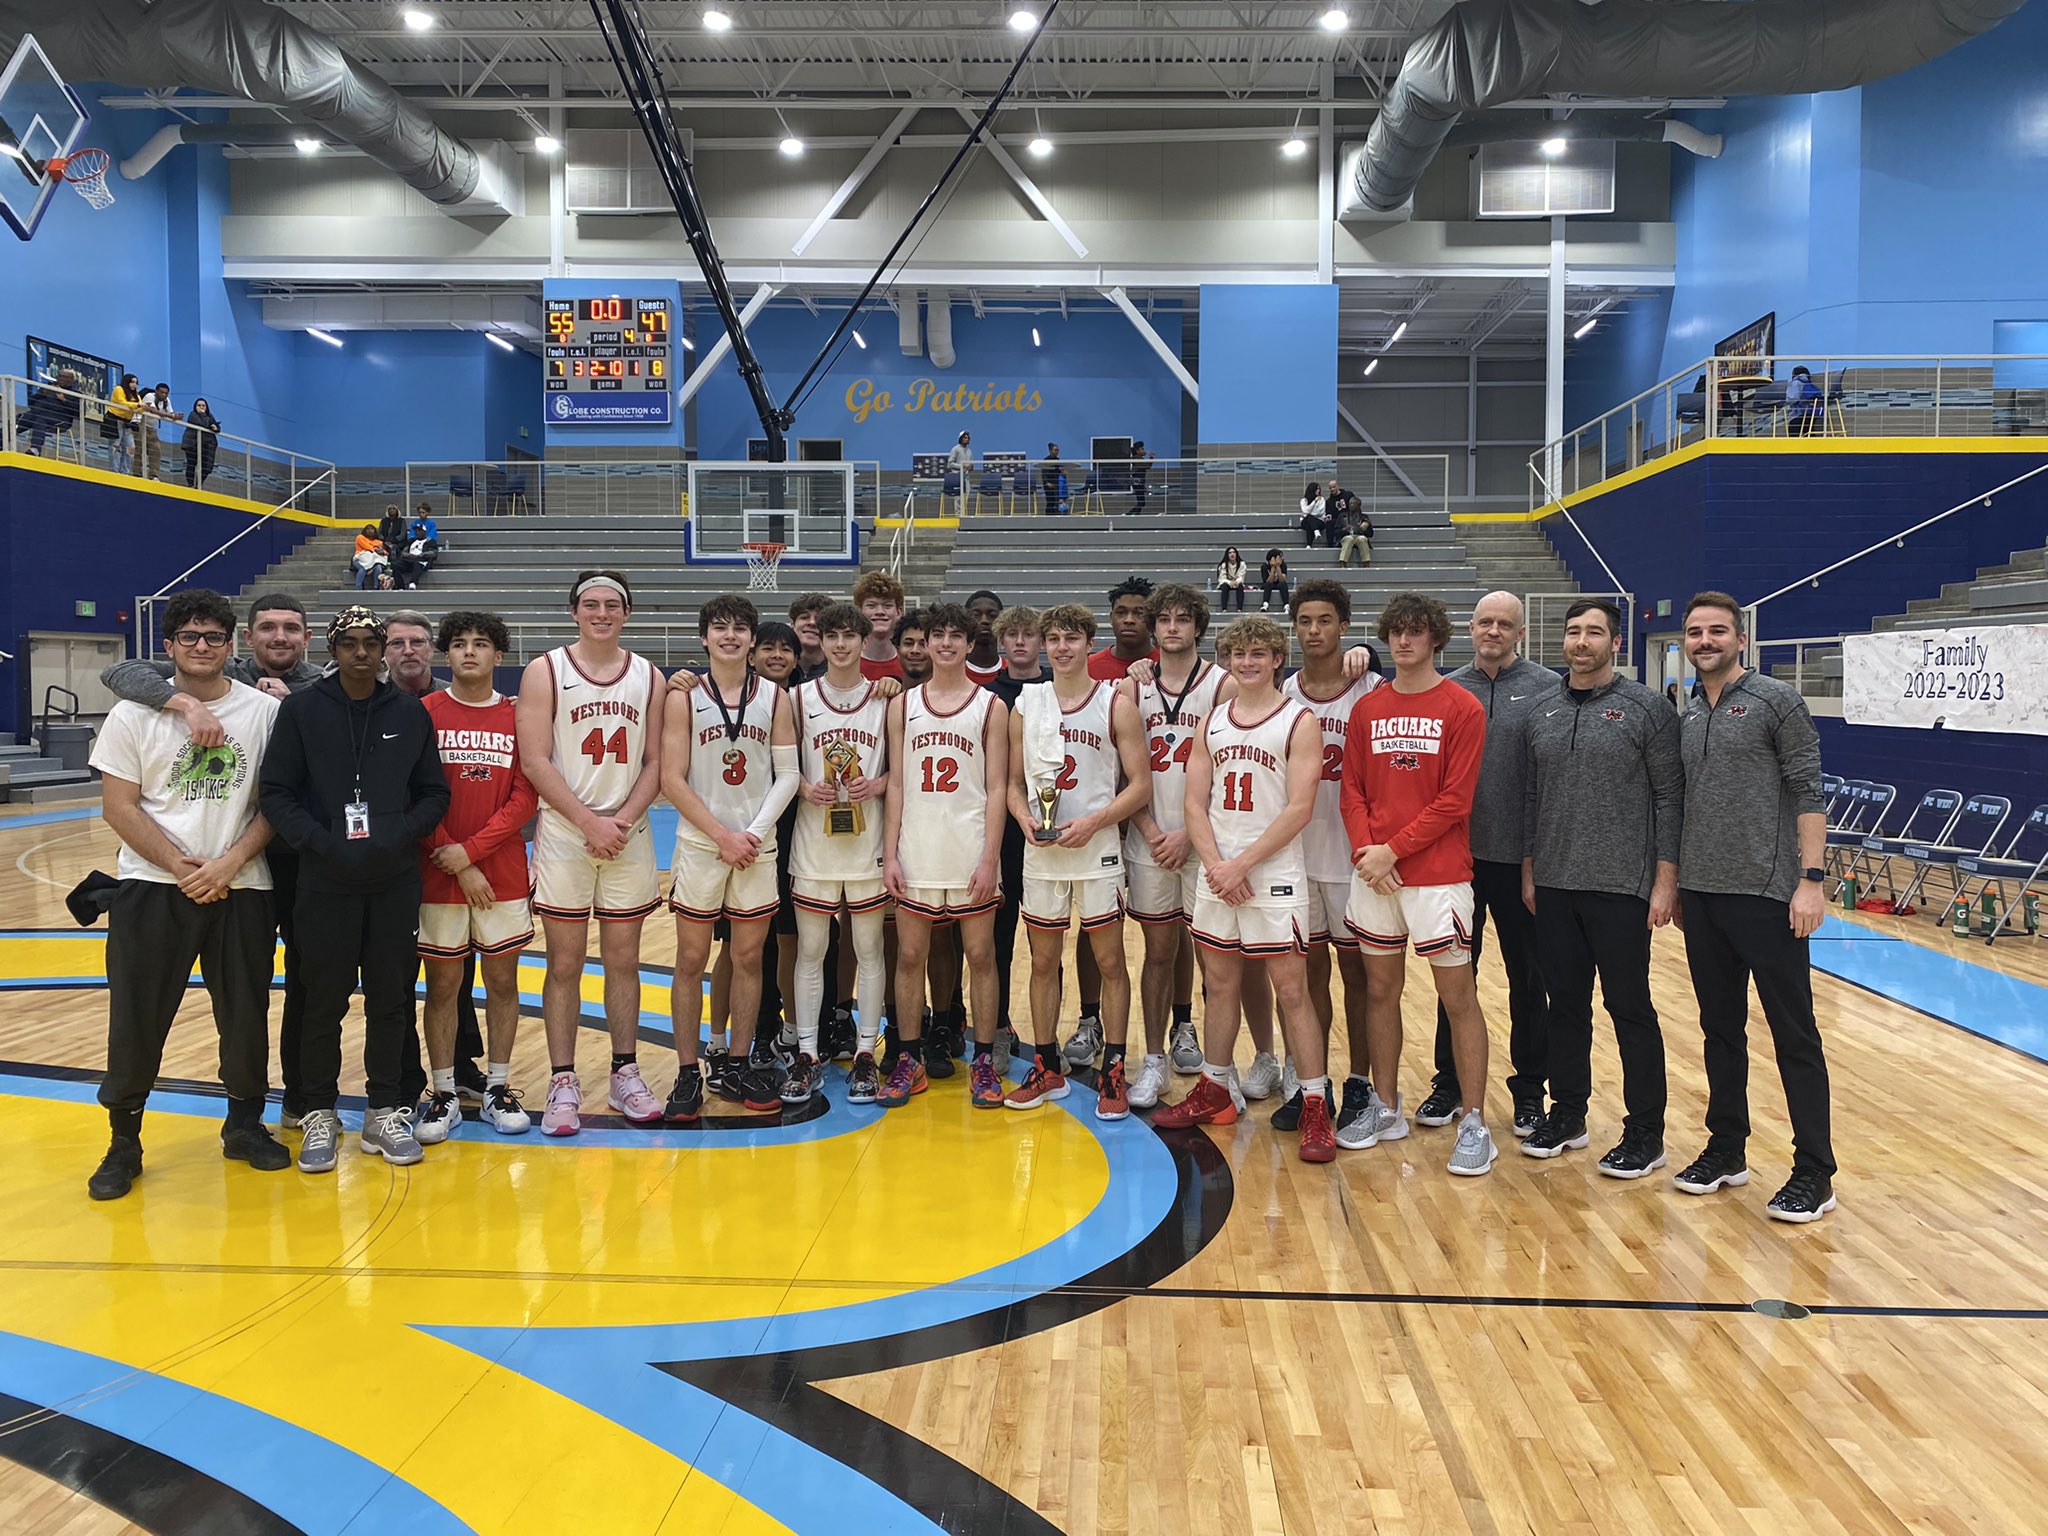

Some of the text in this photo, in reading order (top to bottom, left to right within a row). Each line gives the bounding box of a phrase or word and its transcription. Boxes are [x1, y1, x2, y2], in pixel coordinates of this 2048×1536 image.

[549, 301, 570, 310] Home
[591, 299, 621, 320] 0.0
[639, 300, 665, 310] Guests
[550, 312, 574, 333] 55
[641, 312, 666, 332] 47
[593, 333, 618, 343] period
[624, 329, 635, 343] 4
[548, 347, 565, 356] fouls
[594, 347, 617, 356] player
[647, 347, 664, 356] fouls
[554, 361, 564, 375] 7
[574, 361, 583, 376] 3
[653, 360, 662, 376] 8
[550, 381, 565, 389] won
[597, 381, 616, 390] game
[845, 378, 1042, 424] Go Patriots
[590, 407, 648, 415] CONSTRUCTION
[1923, 636, 1989, 673] Family
[1904, 672, 2004, 700] 2022-2023
[570, 701, 640, 726] WESTMOORE
[699, 723, 768, 747] WESOORE
[1371, 717, 1443, 739] JAGUARS
[436, 729, 514, 753] JAGUARS
[581, 726, 628, 765] 44
[1381, 740, 1428, 750] BASKETBALL
[449, 752, 502, 764] BASKETBALL
[1151, 736, 1194, 773] 24
[232, 742, 248, 789] CHAMPIONS
[722, 749, 747, 785] 3
[921, 756, 960, 792] 12
[1223, 771, 1254, 812] 11
[1860, 789, 1871, 799] PC
[1923, 796, 1935, 807] PC
[1966, 801, 2002, 815] PC WEST
[2031, 811, 2043, 822] PC
